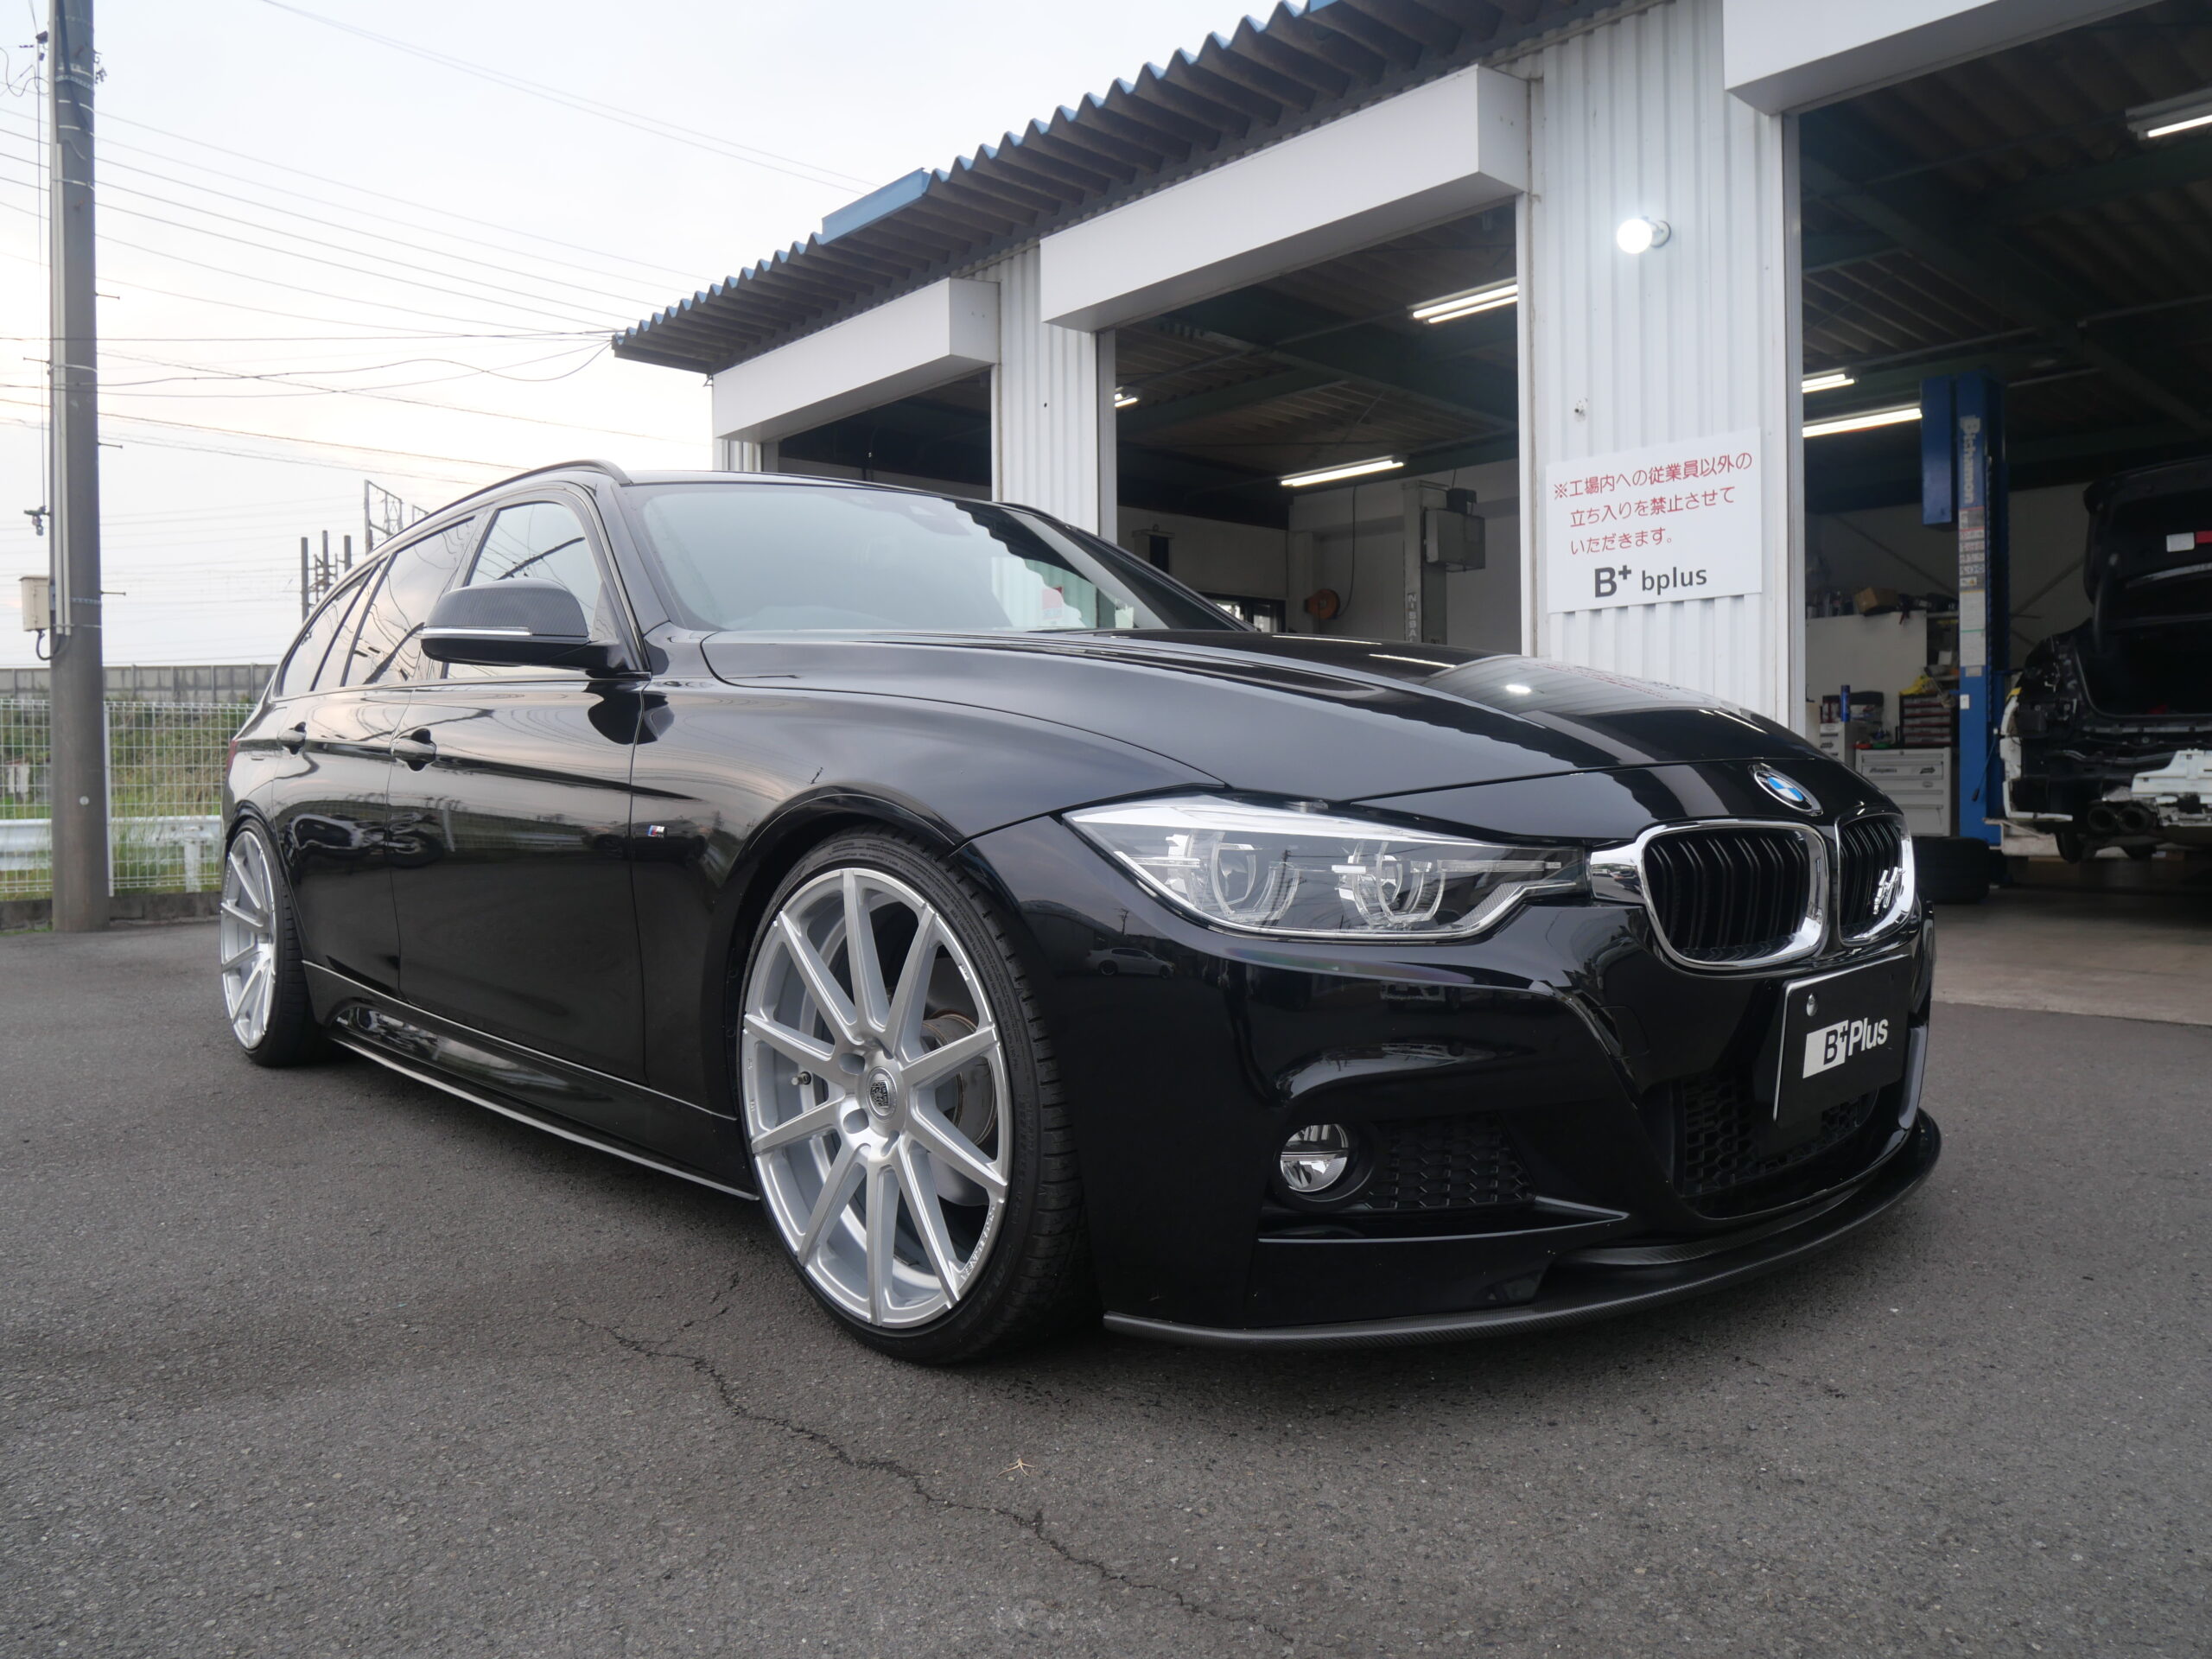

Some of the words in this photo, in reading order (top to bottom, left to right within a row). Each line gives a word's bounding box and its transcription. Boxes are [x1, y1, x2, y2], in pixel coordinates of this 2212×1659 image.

[1570, 486, 1736, 528] 立ち入りを禁止させて
[1570, 526, 1672, 556] いただきます。
[1641, 567, 1707, 595] bplus
